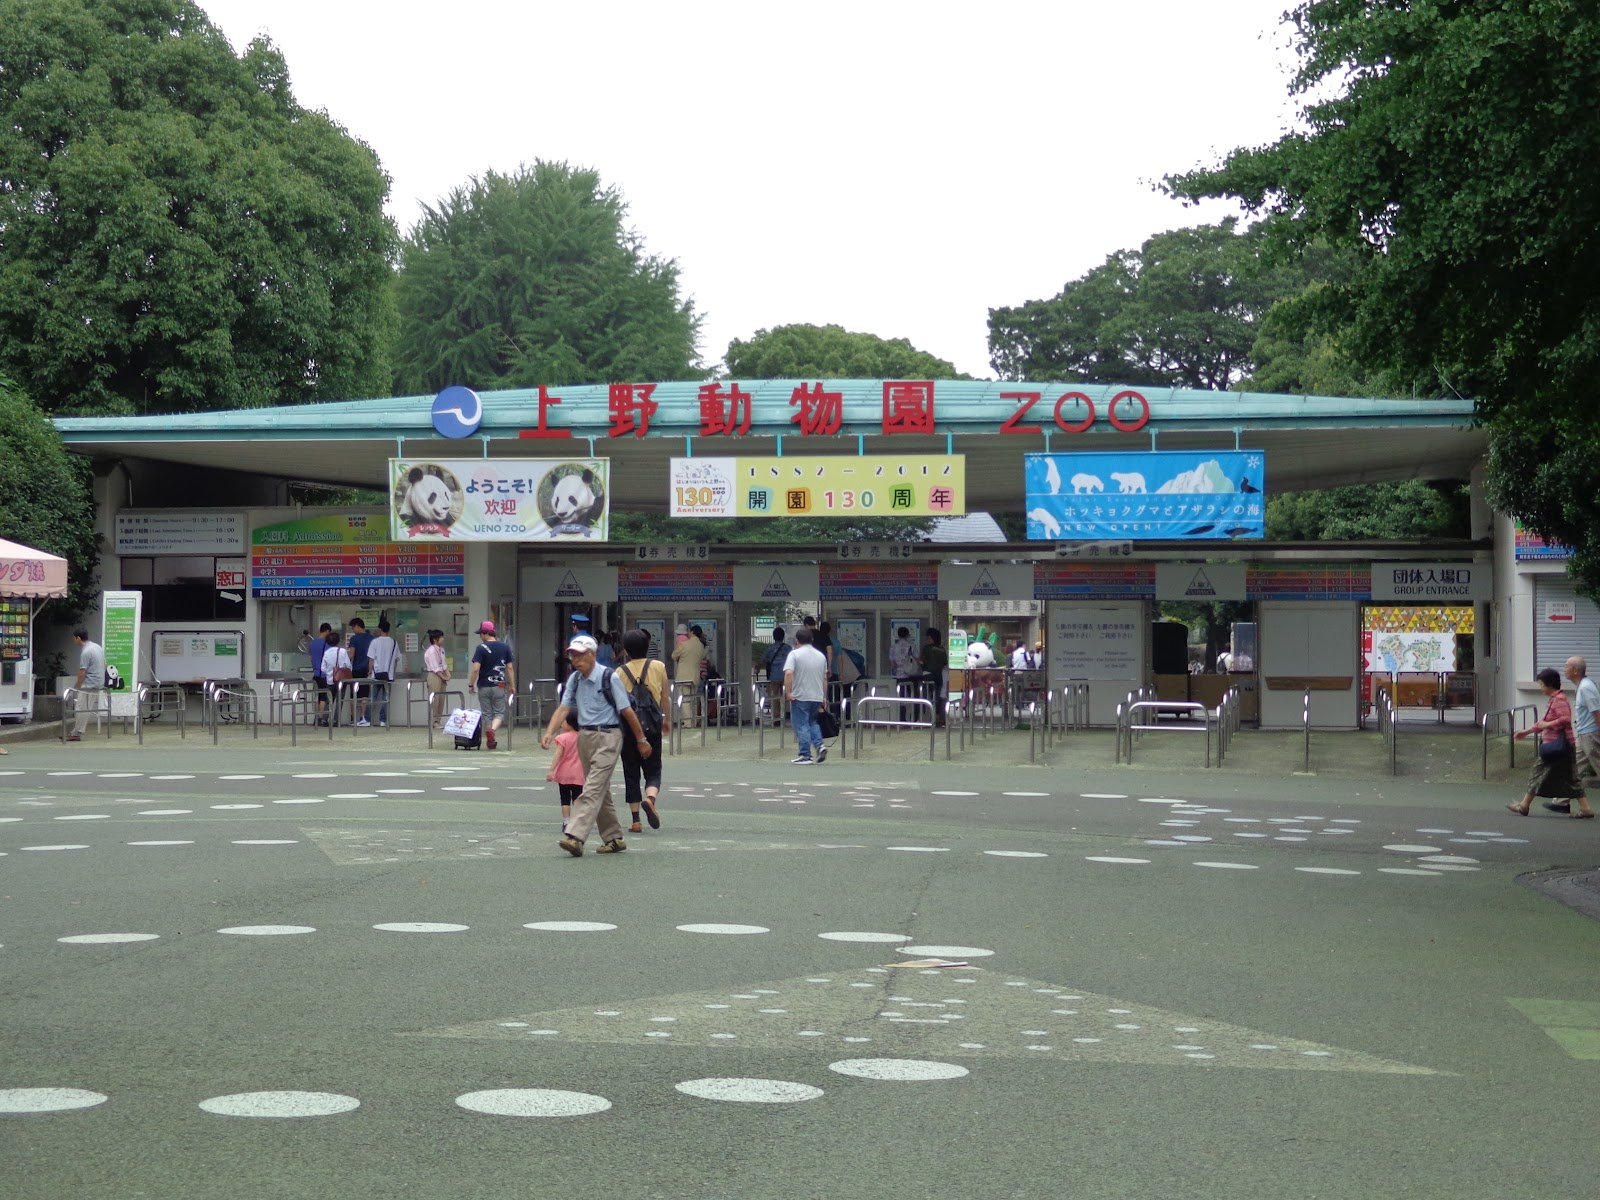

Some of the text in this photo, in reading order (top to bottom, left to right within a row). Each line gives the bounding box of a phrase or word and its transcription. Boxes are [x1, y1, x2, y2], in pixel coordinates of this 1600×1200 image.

[519, 381, 1150, 439] 上野動物園 ZOO
[466, 479, 533, 494] ようこそ!
[485, 500, 517, 516] 欢迎
[1065, 504, 1260, 516] ホッキョクグマとアザラシの海
[294, 531, 344, 542] Admission
[474, 525, 527, 533] UENO ZOO
[216, 571, 245, 587] 窓口
[1393, 569, 1472, 584] 団体入場口
[1394, 586, 1471, 595] GROUP ENTRANCE
